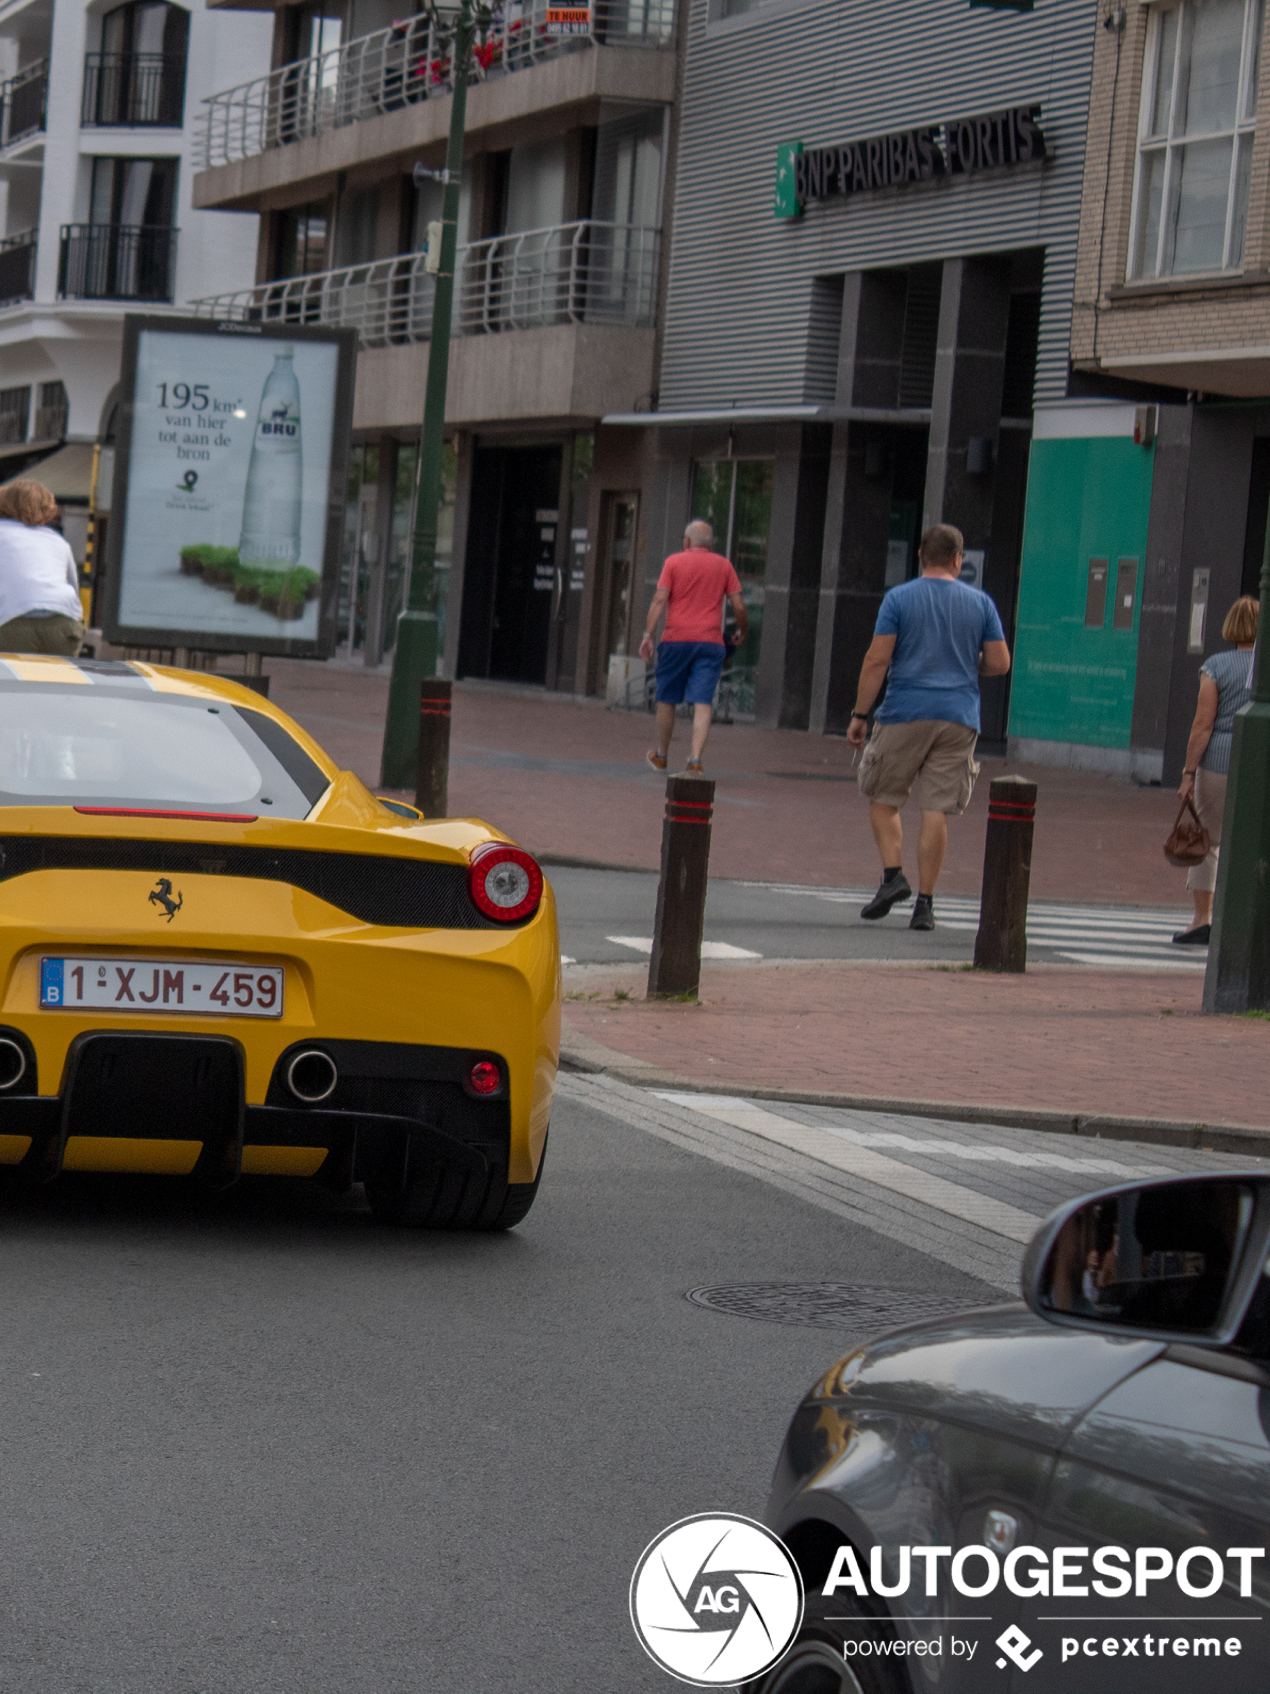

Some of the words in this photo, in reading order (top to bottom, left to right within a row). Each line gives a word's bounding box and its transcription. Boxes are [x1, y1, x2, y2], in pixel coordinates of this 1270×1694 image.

[550, 11, 560, 20] TE
[794, 147, 836, 199] BNP
[838, 129, 937, 193] PARIBAS
[944, 105, 1034, 175] FORTIS
[156, 382, 210, 411] 195
[166, 415, 191, 427] van
[197, 414, 227, 429] hier
[262, 423, 296, 436] BRU
[158, 431, 177, 443] tot
[183, 433, 209, 445] aan
[214, 433, 231, 446] de
[177, 445, 210, 460] bron
[47, 986, 59, 1002] B
[71, 965, 276, 1008] 1-XJM-459
